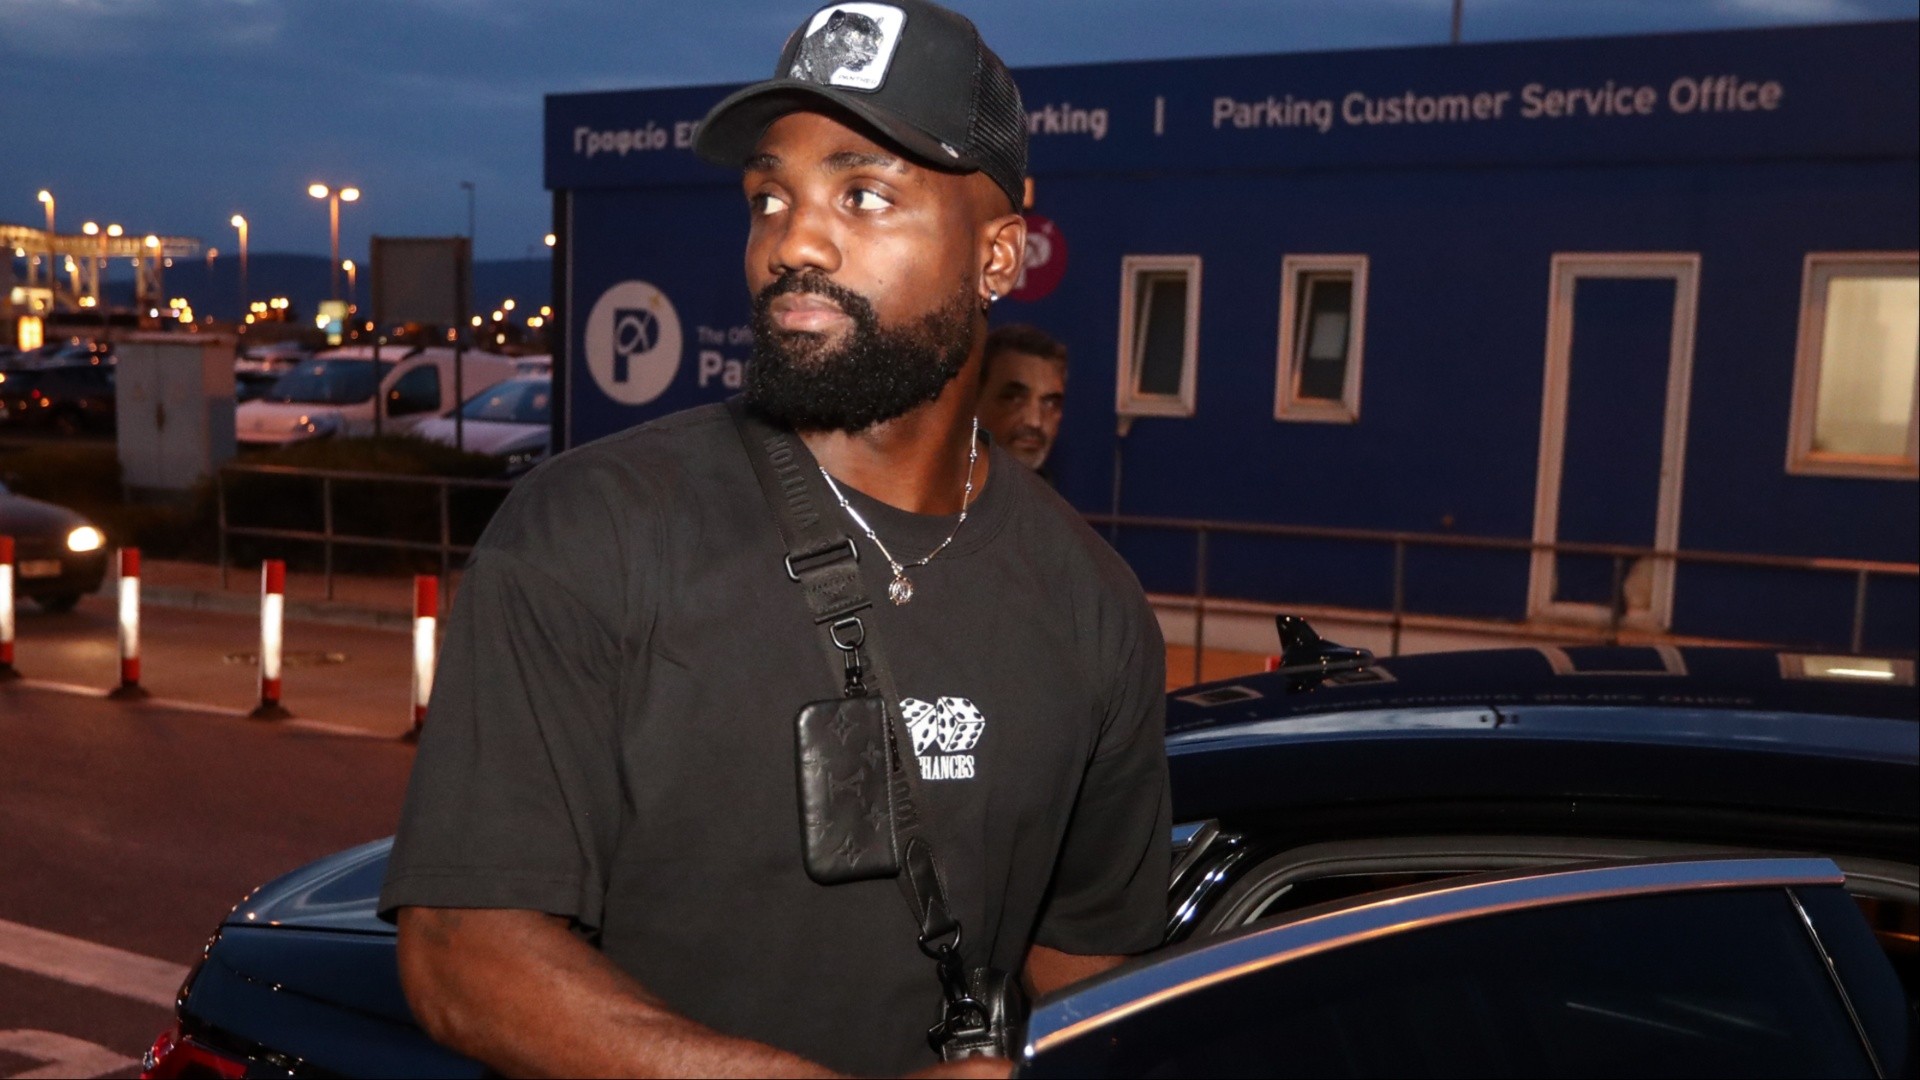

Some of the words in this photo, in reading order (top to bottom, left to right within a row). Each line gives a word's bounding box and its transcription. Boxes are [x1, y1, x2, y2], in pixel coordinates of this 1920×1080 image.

[838, 74, 878, 85] PANTHER
[1212, 95, 1333, 133] Parking
[1342, 90, 1511, 124] Customer
[1520, 80, 1657, 118] Service
[1668, 76, 1783, 114] Office
[574, 121, 668, 158] Γραφείο
[1028, 102, 1108, 141] rking
[697, 325, 725, 345] The
[698, 350, 745, 389] Pa
[762, 432, 820, 530] VUITTON
